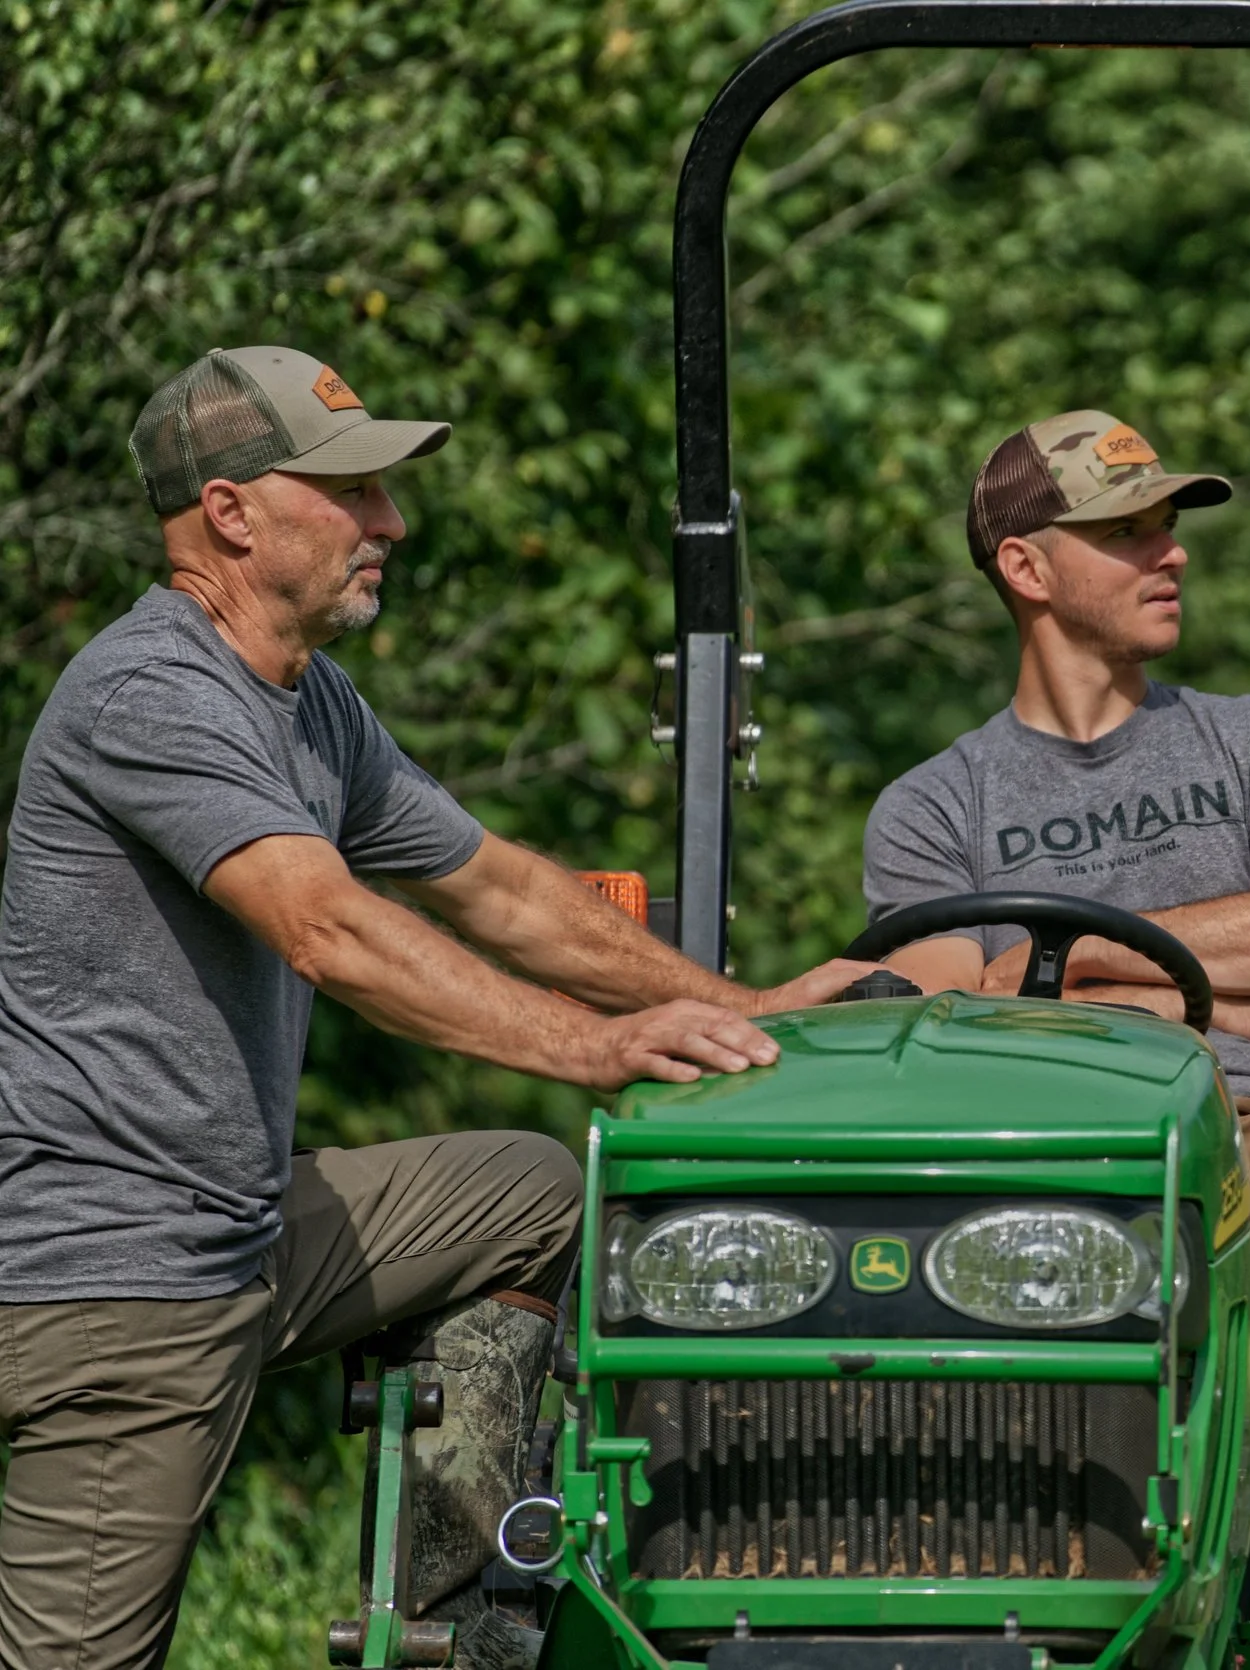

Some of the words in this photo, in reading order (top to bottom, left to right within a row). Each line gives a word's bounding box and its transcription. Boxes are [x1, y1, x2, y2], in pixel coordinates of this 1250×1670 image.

[996, 780, 1230, 865] DOMAIN
[1054, 863, 1087, 877] This
[1091, 861, 1104, 872] is
[1108, 852, 1141, 870] your
